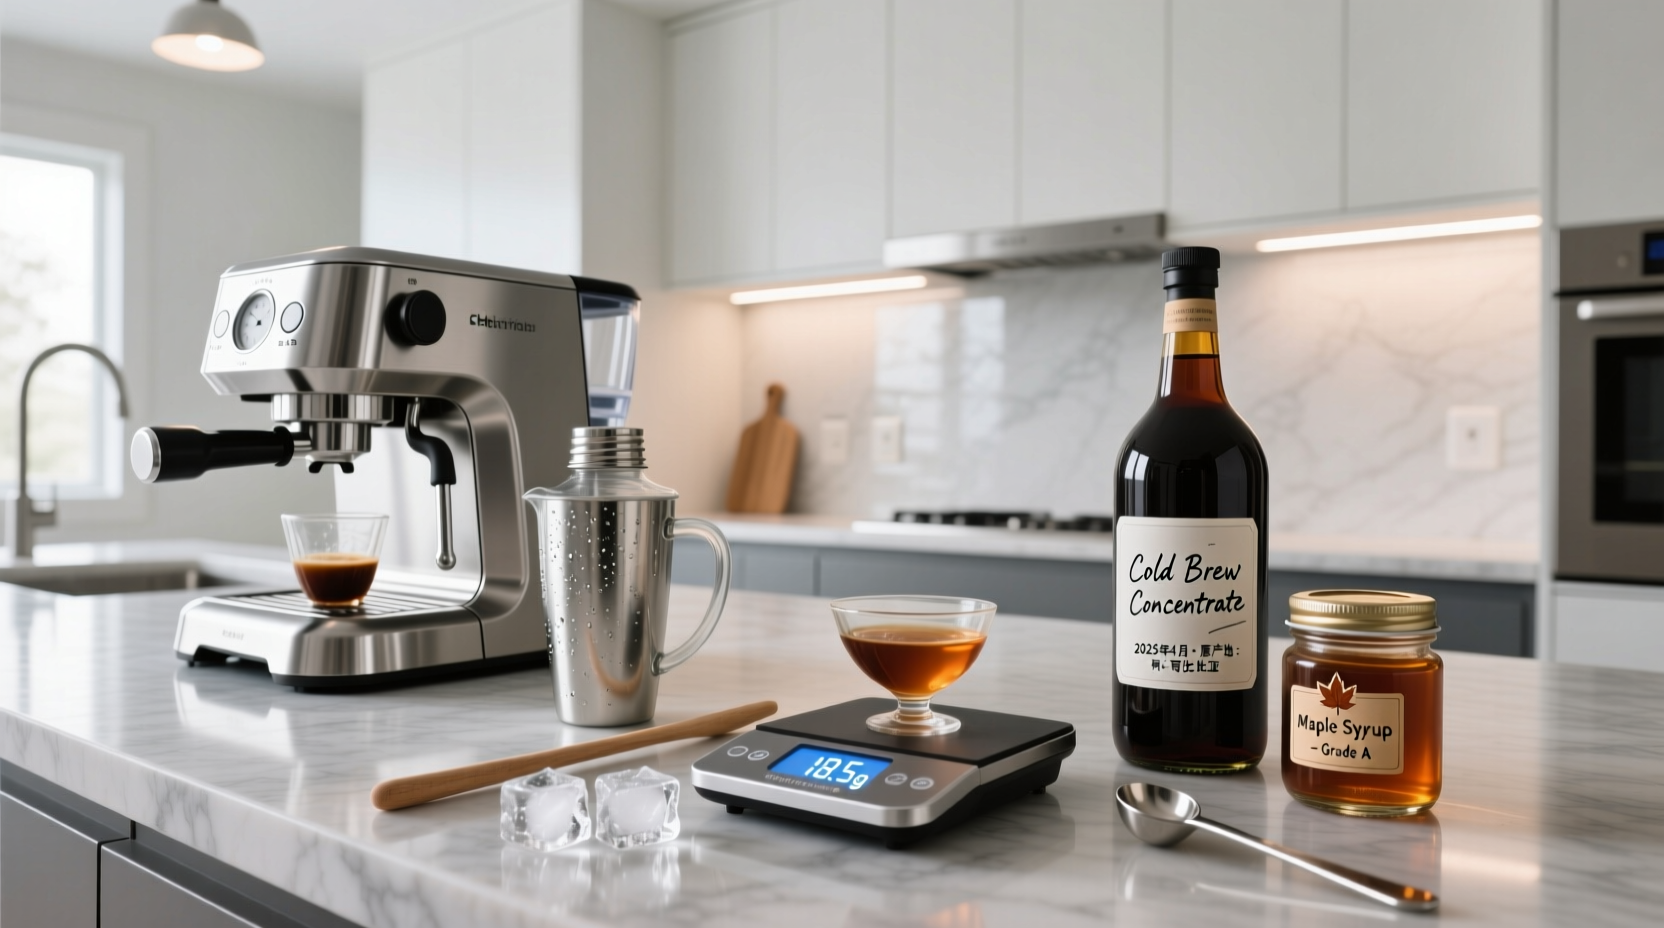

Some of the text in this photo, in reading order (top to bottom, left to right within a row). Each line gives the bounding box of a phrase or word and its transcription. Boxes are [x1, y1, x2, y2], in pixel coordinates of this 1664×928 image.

[1129, 553, 1241, 584] Cold Brew
[1129, 589, 1245, 616] Concentrate
[1297, 713, 1338, 737] Maple
[1321, 742, 1357, 759] Grade
[1361, 746, 1372, 760] A
[804, 756, 869, 790] 18.5g
